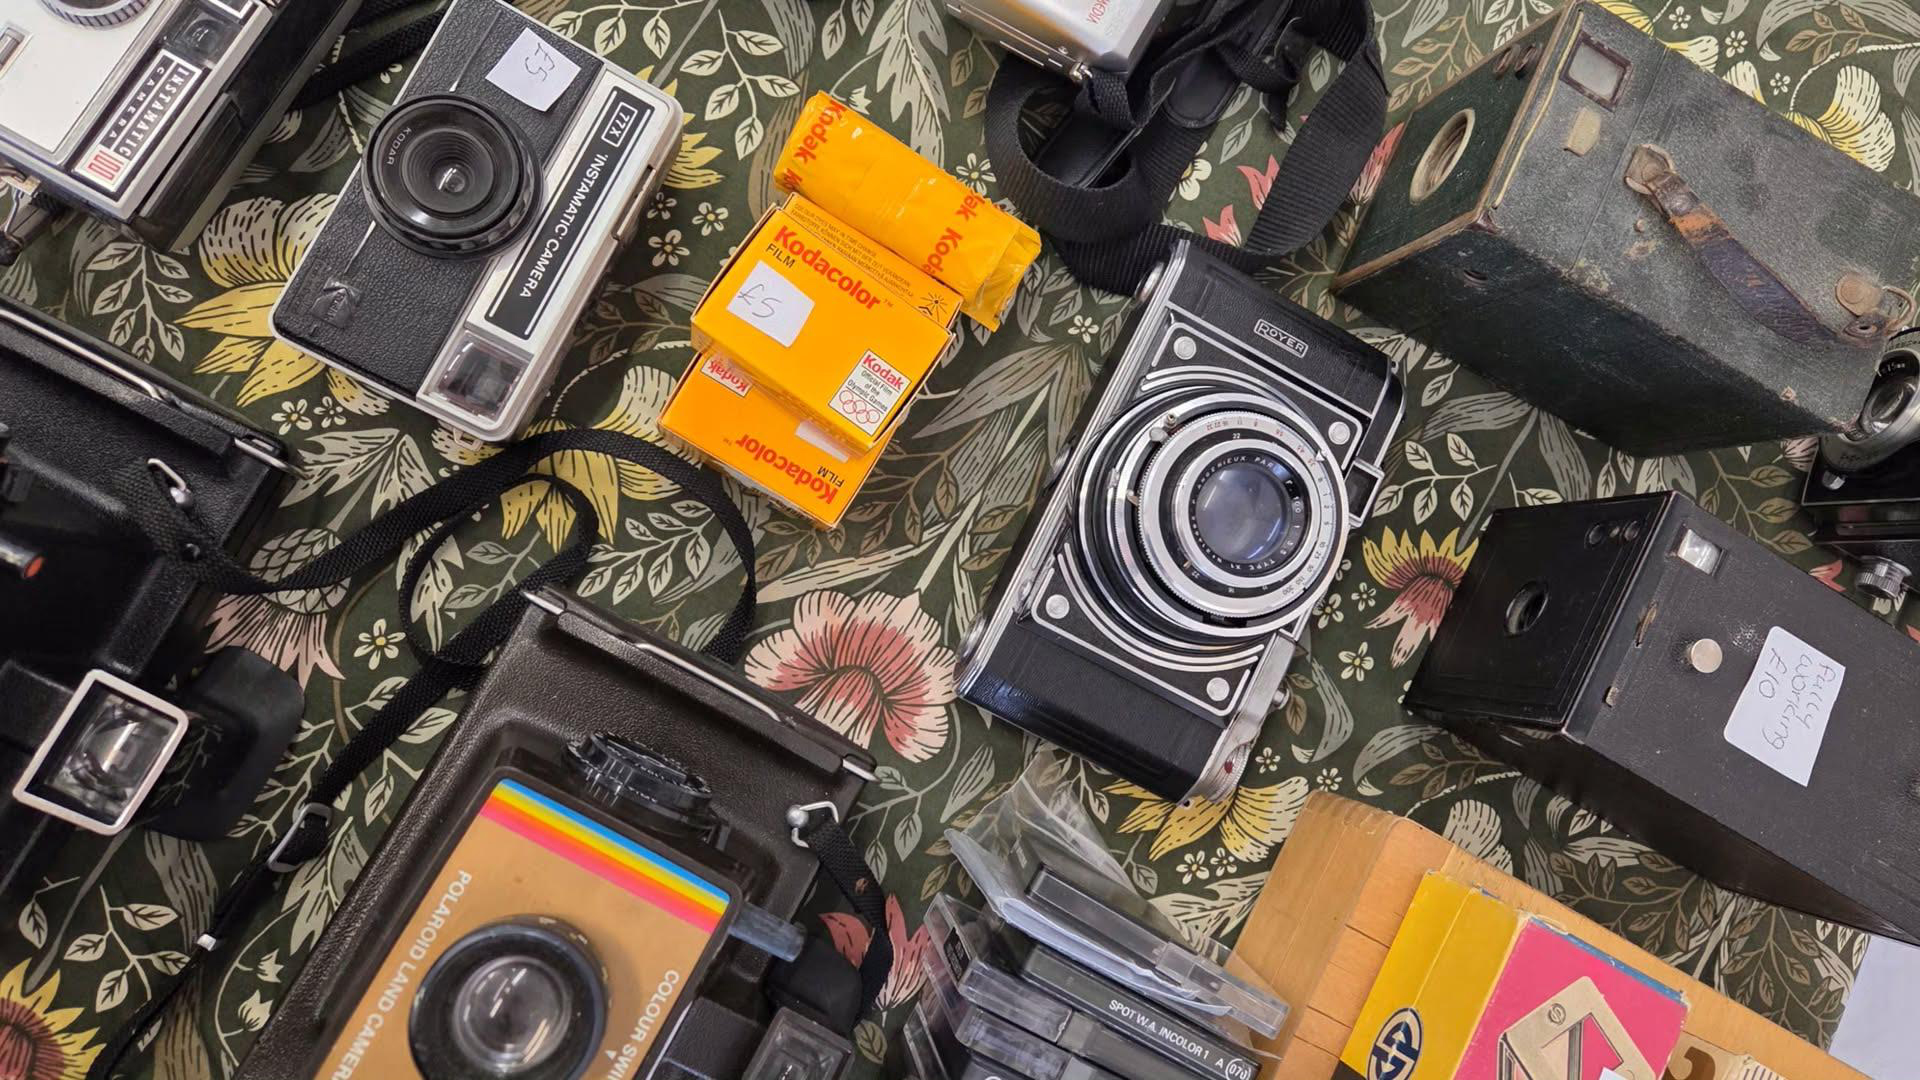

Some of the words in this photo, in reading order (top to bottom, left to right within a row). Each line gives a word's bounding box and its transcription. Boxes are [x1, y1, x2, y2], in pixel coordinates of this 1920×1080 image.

[108, 66, 165, 140] CAMERA
[119, 65, 191, 158] INSTAMATIC
[608, 110, 633, 140] 77X
[387, 126, 412, 165] KODAR
[796, 99, 847, 163] Kodak
[519, 240, 561, 299] CAMERA
[765, 242, 797, 269] FILM
[773, 224, 882, 311] Kodacolor
[738, 283, 783, 319] £5
[1258, 323, 1305, 354] ROYER
[708, 357, 751, 394] Kodak
[847, 379, 870, 398] Olympic
[870, 396, 888, 411] Games
[860, 370, 881, 387] Official
[881, 384, 893, 395] Film
[863, 354, 904, 390] Kodak
[864, 382, 871, 390] of
[871, 387, 880, 396] the
[735, 433, 838, 504] Kodacolor
[816, 464, 844, 488] FILM
[1758, 647, 1788, 699] £10
[409, 869, 473, 961] POLAROID
[378, 960, 417, 1013] LAND
[629, 969, 680, 1042] COLOUR
[328, 1012, 385, 1080] CAMER
[1108, 999, 1137, 1020] SPOT
[1136, 1011, 1157, 1033] W.A.
[1157, 1026, 1204, 1057] INCOLOR
[1214, 1058, 1224, 1069] A
